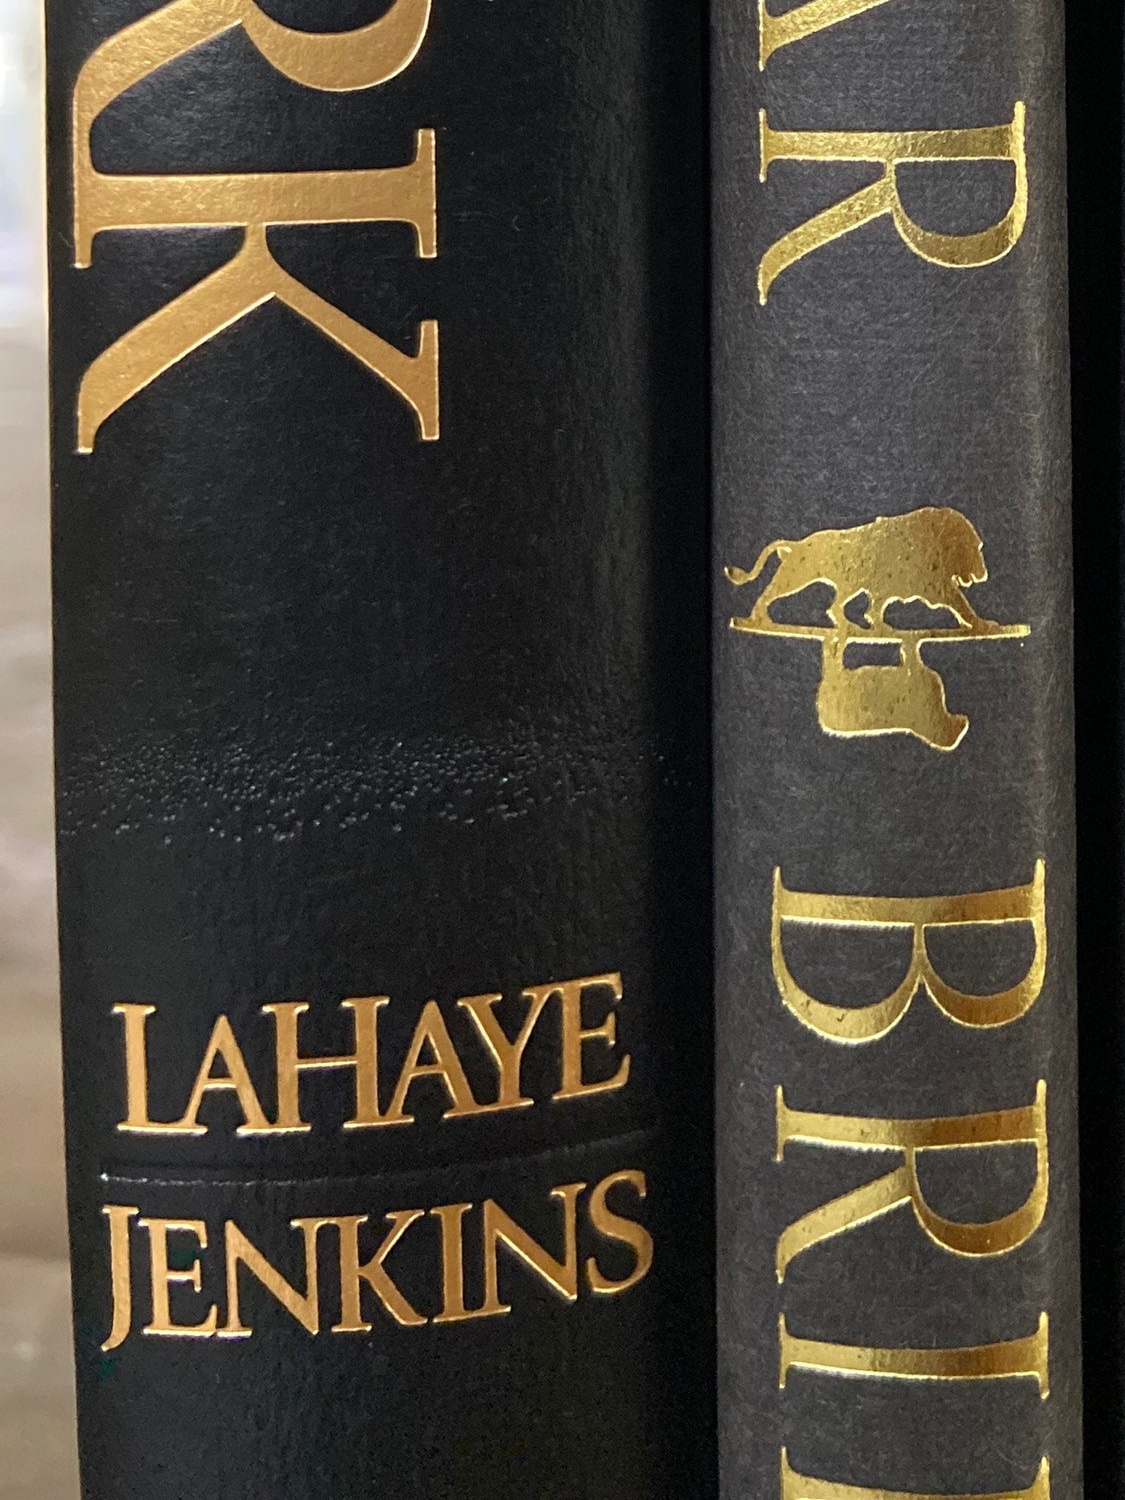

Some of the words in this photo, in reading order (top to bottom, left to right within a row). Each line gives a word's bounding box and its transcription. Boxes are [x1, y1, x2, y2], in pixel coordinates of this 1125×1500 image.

[113, 972, 630, 1134] LAHAYE
[102, 1170, 653, 1351] JENKINS
[770, 856, 1051, 1500] BRI
